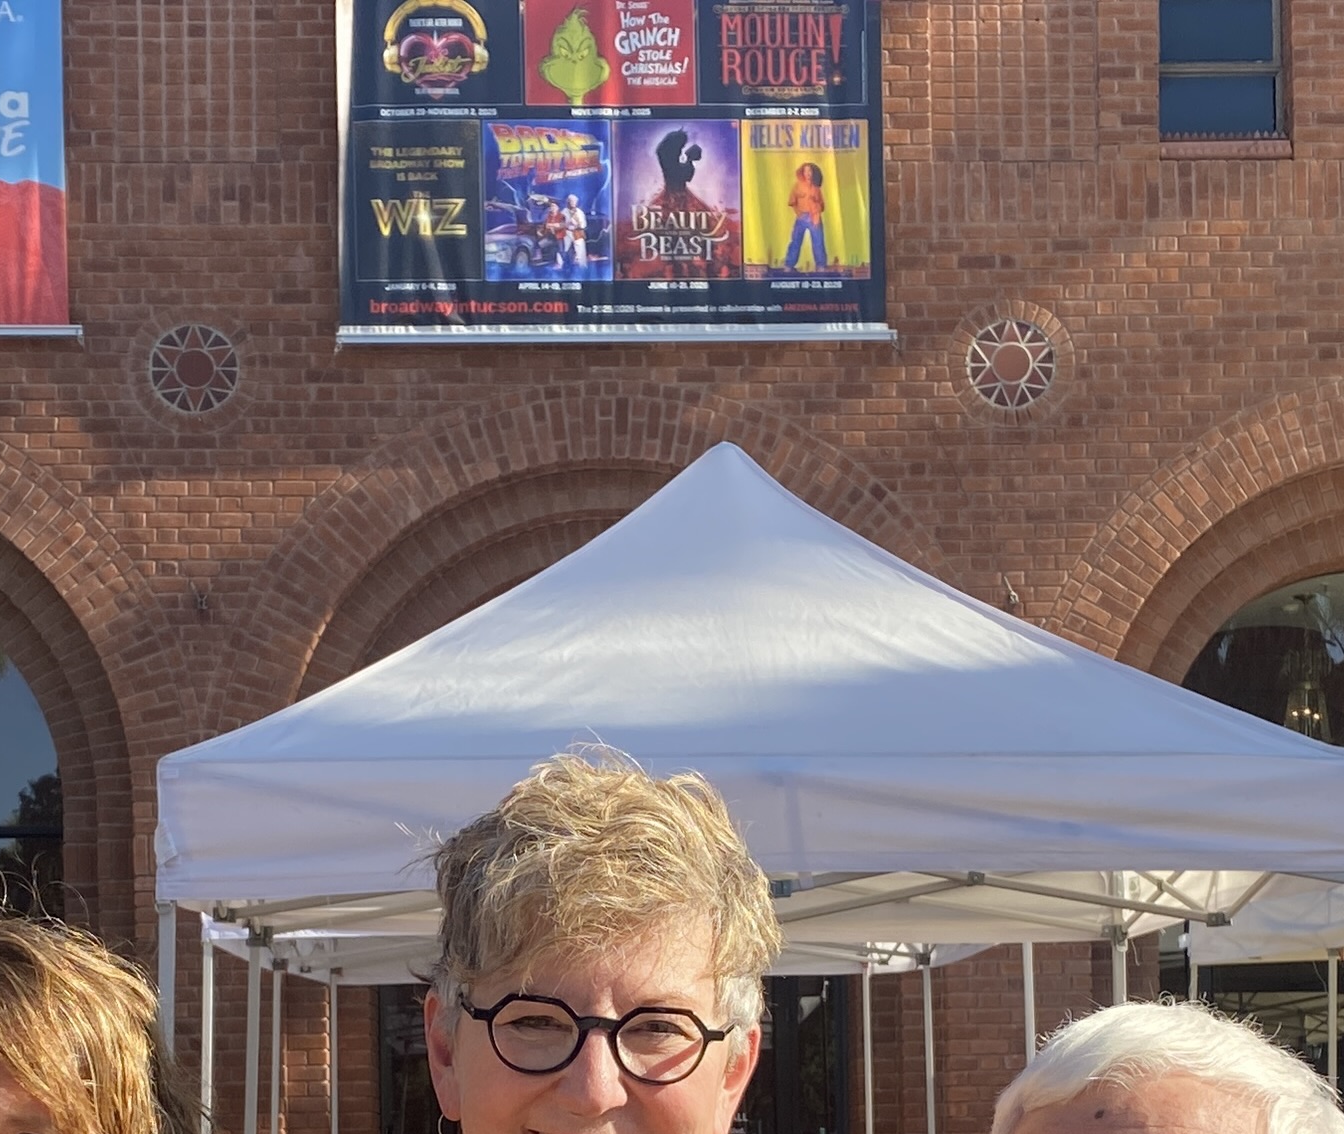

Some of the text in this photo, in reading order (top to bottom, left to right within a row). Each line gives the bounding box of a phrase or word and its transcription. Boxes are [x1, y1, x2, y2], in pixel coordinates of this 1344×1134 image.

[721, 13, 825, 48] MOULIN
[614, 27, 680, 54] GRINCH
[638, 50, 673, 62] STOLE
[621, 57, 689, 75] CHRISTMAS!
[627, 77, 677, 86] THE MUSICAL
[380, 108, 415, 116] OCTOBER
[571, 108, 612, 116] NOVEMBER
[745, 108, 786, 116] DECEMBER
[487, 123, 594, 154] BACK
[750, 124, 860, 148] HELL'S KITCHEN
[370, 147, 463, 157] THE LEGENDARY
[369, 159, 465, 168] BROADWAY SHOW
[500, 150, 602, 185] TO FUTURE
[396, 172, 438, 181] IS BACK
[370, 198, 467, 236] WIZ
[631, 204, 726, 236] BEAUTY
[628, 231, 728, 261] BEAST
[385, 283, 421, 291] JANUARY
[518, 282, 540, 290] APRIL
[648, 282, 668, 290] JUNE
[770, 281, 800, 289] AUGUST
[369, 299, 569, 317] broadwayintucson.com
[576, 304, 591, 313] The
[672, 304, 709, 314] presented
[718, 304, 765, 312] collaboration
[766, 304, 782, 312] with
[783, 303, 817, 312] ARIZONA
[819, 303, 840, 312] ARTS
[841, 303, 860, 312] LIVE
